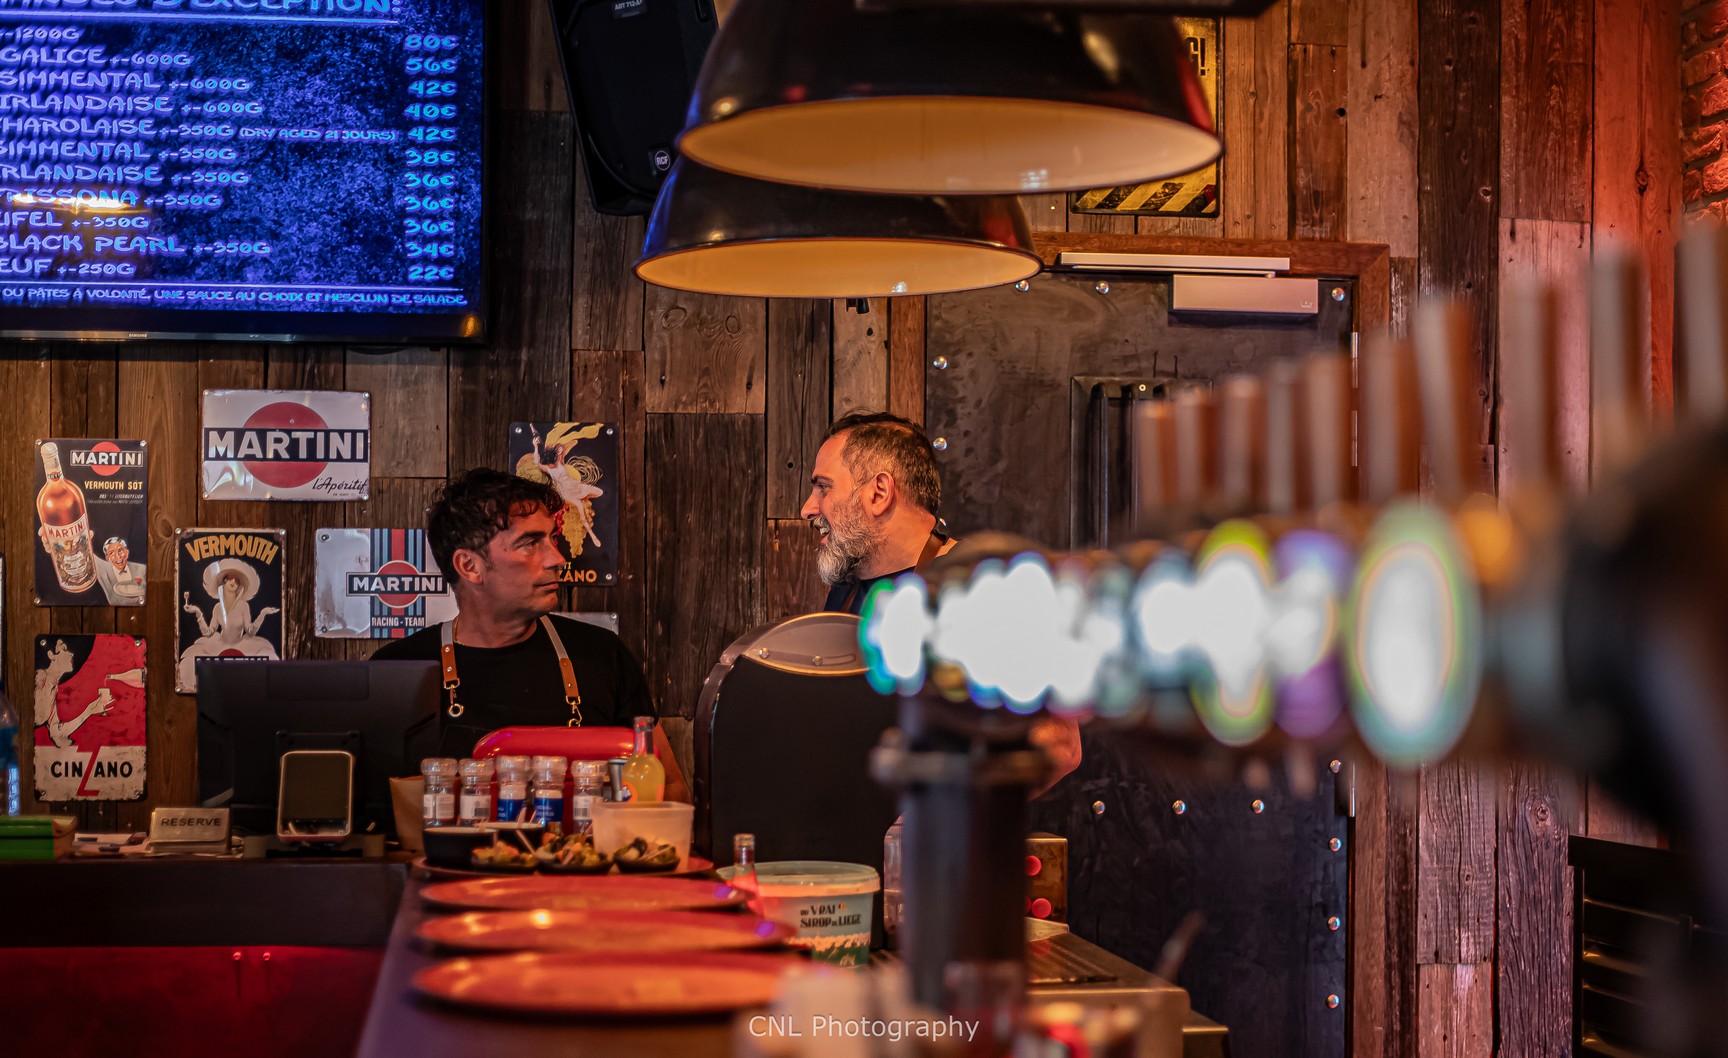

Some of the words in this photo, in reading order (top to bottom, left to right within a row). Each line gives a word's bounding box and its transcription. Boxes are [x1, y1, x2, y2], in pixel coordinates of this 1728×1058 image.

[0, 27, 81, 40] -1200G
[404, 34, 459, 50] 80€
[1, 48, 107, 65] GALICE
[109, 53, 191, 67] +-600G
[405, 57, 458, 73] 56€
[0, 71, 162, 90] SIMMENTAL
[168, 78, 251, 91] +-600G
[408, 80, 458, 95] 42€
[181, 101, 263, 114] +-600G
[404, 103, 457, 118] 40€
[0, 117, 157, 136] HAROLAISE
[158, 124, 234, 138] +-350G
[239, 127, 275, 138] (DRY
[279, 129, 321, 139] AGED
[408, 126, 457, 141] 42€
[158, 148, 236, 160] +-350G
[405, 150, 455, 165] 38€
[0, 164, 164, 182] RLANDAISE
[171, 171, 249, 184] +-350G
[404, 173, 454, 188] 36€
[143, 194, 221, 207] +-350G
[404, 196, 454, 211] 36€
[0, 210, 63, 228] IFEL
[71, 216, 149, 229] +-350G
[403, 219, 454, 234] 36€
[94, 236, 185, 253] PEARL
[192, 242, 271, 254] +-350G
[405, 243, 454, 258] 34€
[56, 263, 135, 276] +-250G
[407, 266, 454, 281] 22€
[2, 288, 24, 298] OU
[154, 290, 184, 300] UNE
[187, 291, 233, 301] SAUCE
[236, 292, 255, 301] AU
[208, 430, 364, 460] MARTINI
[72, 452, 142, 465] MARTINI
[84, 481, 124, 490] VERMOUTH
[185, 534, 279, 565] VERMOUTH
[353, 576, 443, 592] MARTINI
[371, 617, 399, 626] RACING
[405, 617, 425, 626] TEAM
[160, 817, 222, 827] RESERVE
